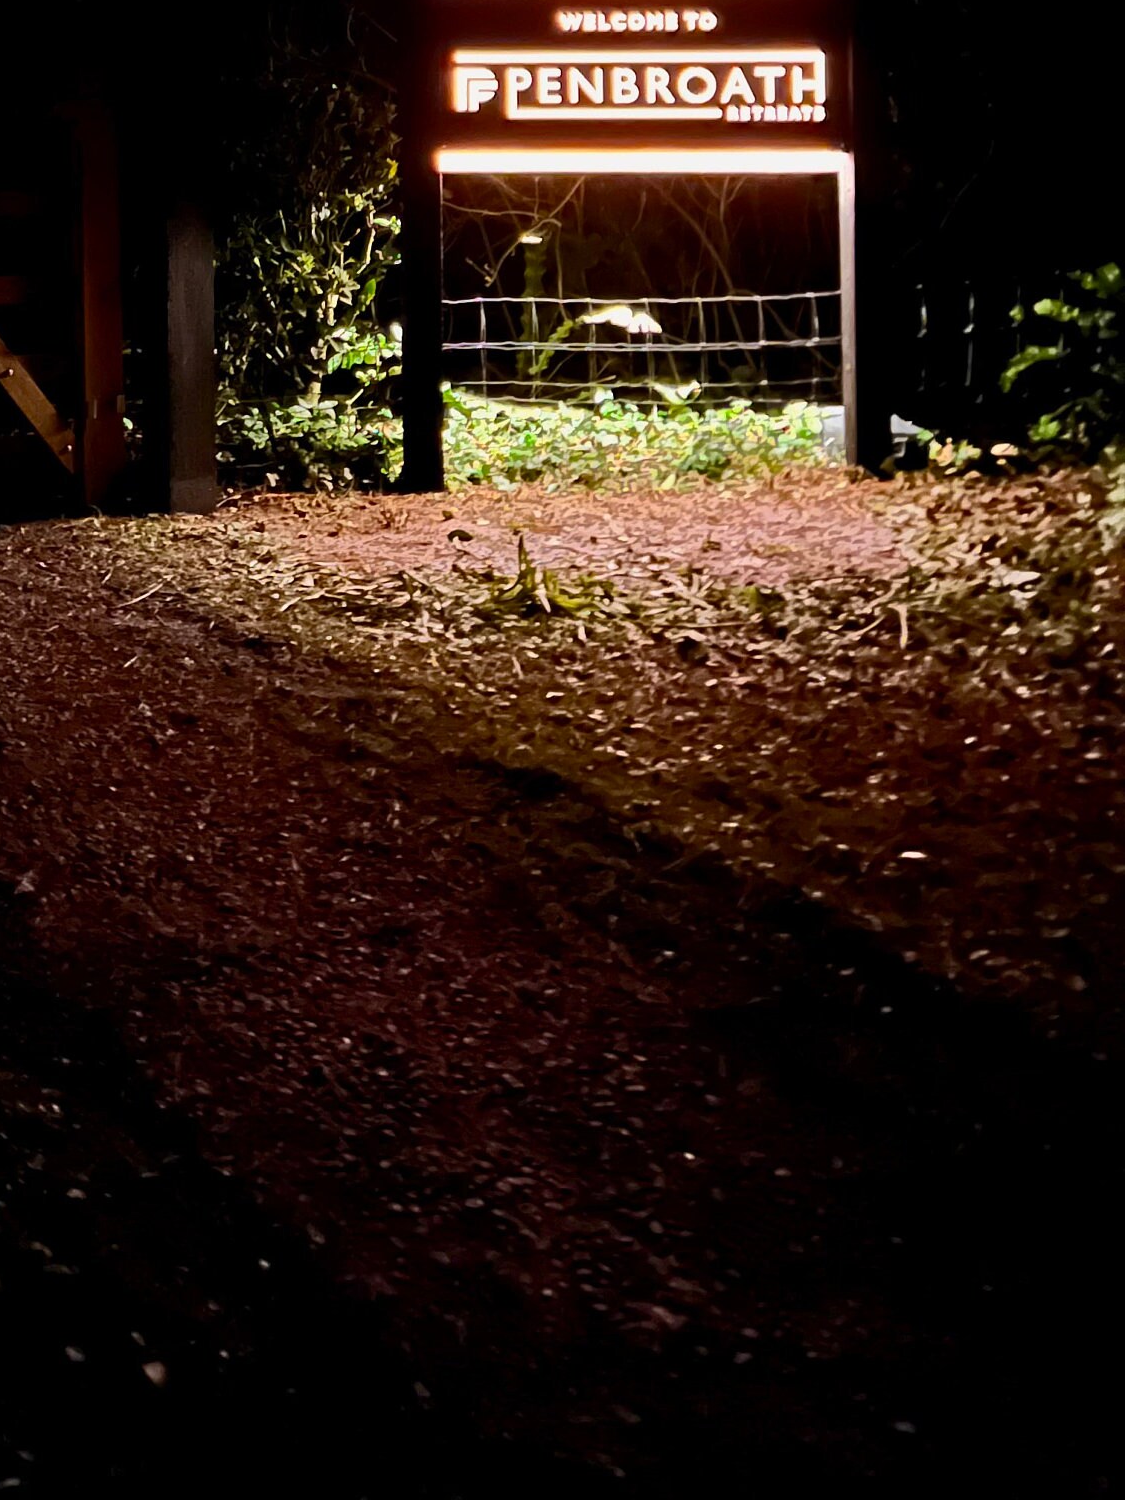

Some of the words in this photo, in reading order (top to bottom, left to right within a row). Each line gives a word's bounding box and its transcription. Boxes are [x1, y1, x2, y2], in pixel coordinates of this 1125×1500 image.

[557, 9, 679, 32] WELCOME
[682, 9, 718, 32] TO
[506, 66, 826, 105] PENBROATH
